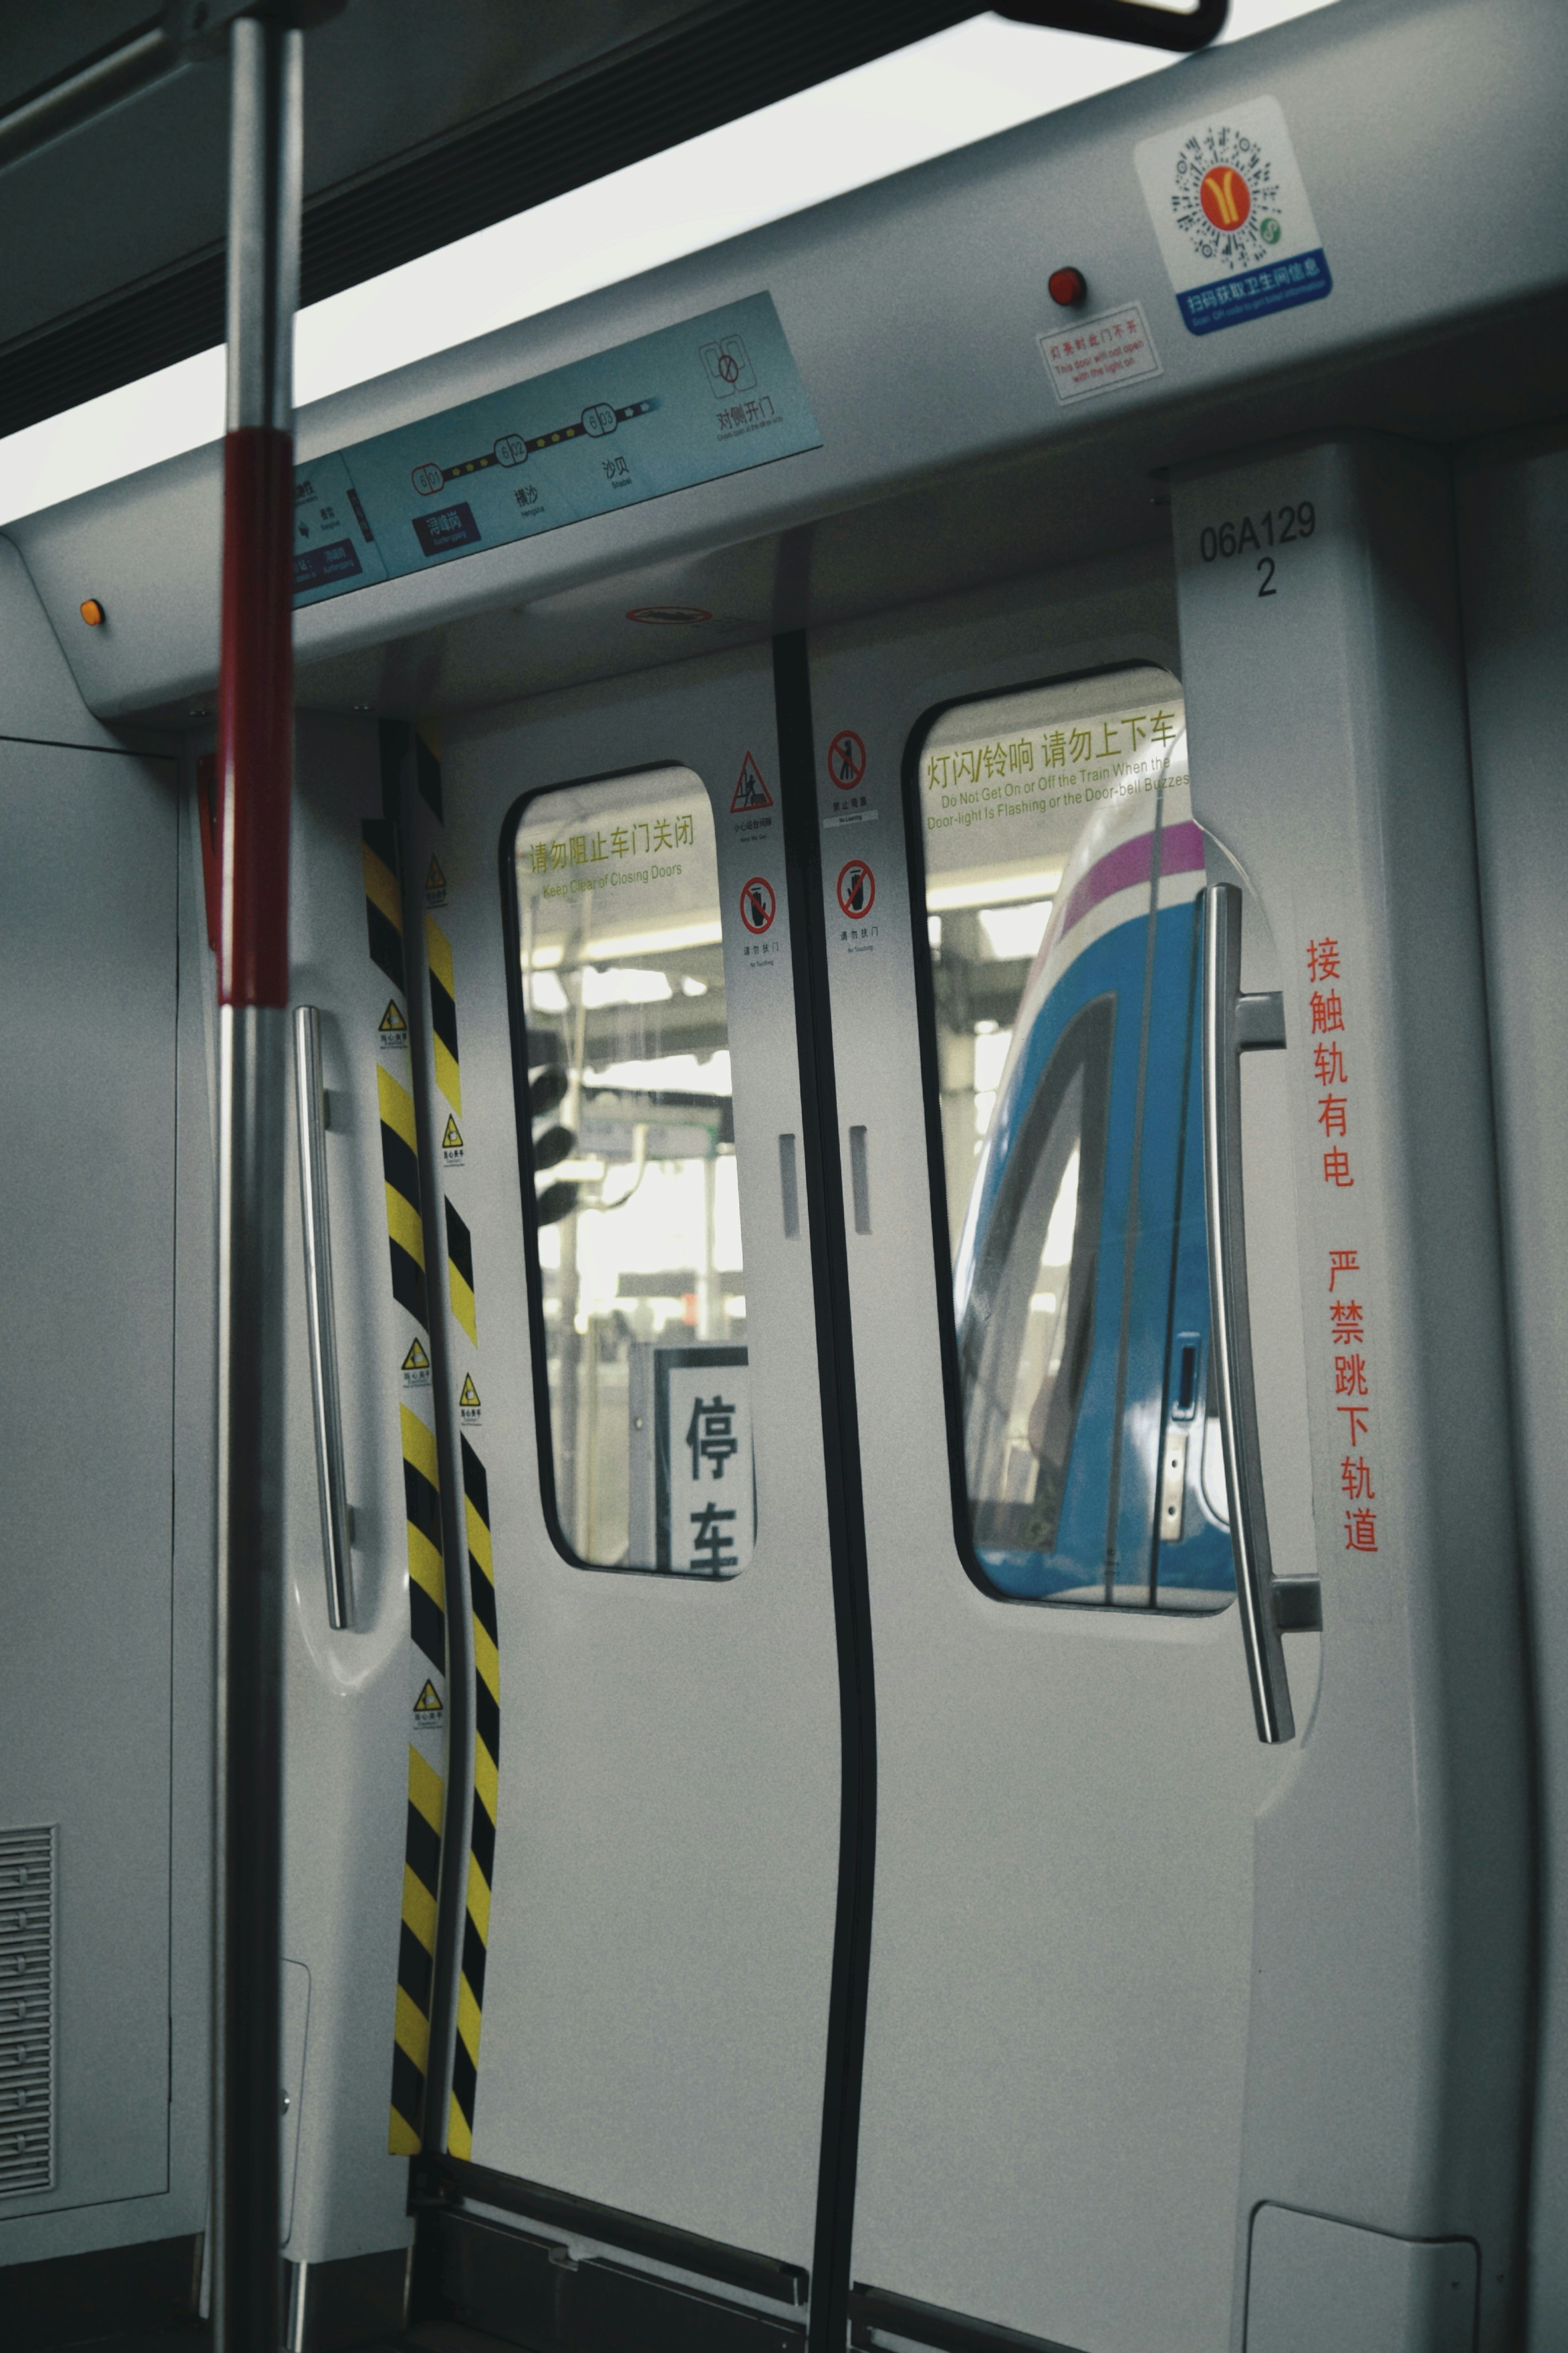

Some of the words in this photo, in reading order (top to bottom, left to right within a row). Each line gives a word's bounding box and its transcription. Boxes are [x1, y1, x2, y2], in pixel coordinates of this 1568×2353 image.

[1186, 257, 1320, 314] 扫码获取卫生间信息
[1051, 320, 1137, 360] 灯亮时此门不开
[1055, 364, 1073, 374] This
[1075, 358, 1092, 369] door
[1094, 351, 1107, 362] will
[1109, 347, 1122, 357] not
[1124, 340, 1144, 353] open
[1073, 372, 1090, 382] with
[1091, 367, 1103, 376] the
[1104, 361, 1123, 373] light
[1124, 358, 1134, 366] on
[590, 417, 597, 428] 6
[599, 411, 613, 426] 03
[716, 396, 774, 430] 对侧开门
[502, 446, 508, 459] 6
[511, 442, 524, 456] 02
[420, 475, 427, 487] 6
[429, 471, 441, 485] 01
[602, 457, 629, 479] 沙贝
[515, 485, 537, 507] 横沙
[426, 510, 462, 536] 浔峰岗
[1201, 501, 1315, 562] 06A129
[1257, 556, 1277, 597] 2
[927, 737, 1033, 790] 灯闪/铃响
[1041, 710, 1177, 769] 请勿上下车
[941, 795, 957, 809] Do
[960, 790, 979, 806] Not
[982, 787, 1001, 802] Get
[1005, 783, 1021, 797] On
[1024, 782, 1035, 794] or
[1038, 775, 1055, 791] Off
[1058, 773, 1076, 786] the
[1079, 768, 1110, 785] Train
[1113, 760, 1147, 776] When
[1150, 756, 1170, 770] the
[927, 810, 983, 830] Door-light
[984, 807, 994, 820] Is
[998, 798, 1046, 819] Flashing
[1049, 796, 1062, 808] or
[1064, 791, 1083, 806] the
[1085, 779, 1141, 802] Door-bell
[1144, 773, 1189, 791] Buzzes
[734, 817, 771, 833] 小心站台间隙
[529, 814, 694, 874] 请勿阻止车门关闭
[543, 883, 568, 898] Keep
[570, 879, 596, 894] Clear
[599, 874, 608, 889] of
[611, 870, 649, 886] Closing
[651, 864, 682, 879] Doors
[744, 941, 779, 955] 请勿扶门
[840, 926, 878, 941] 请勿扶门
[1307, 936, 1354, 1187] 接触轨有电
[1328, 1249, 1379, 1553] 严禁跳下轨道
[686, 1395, 738, 1576] 停车
